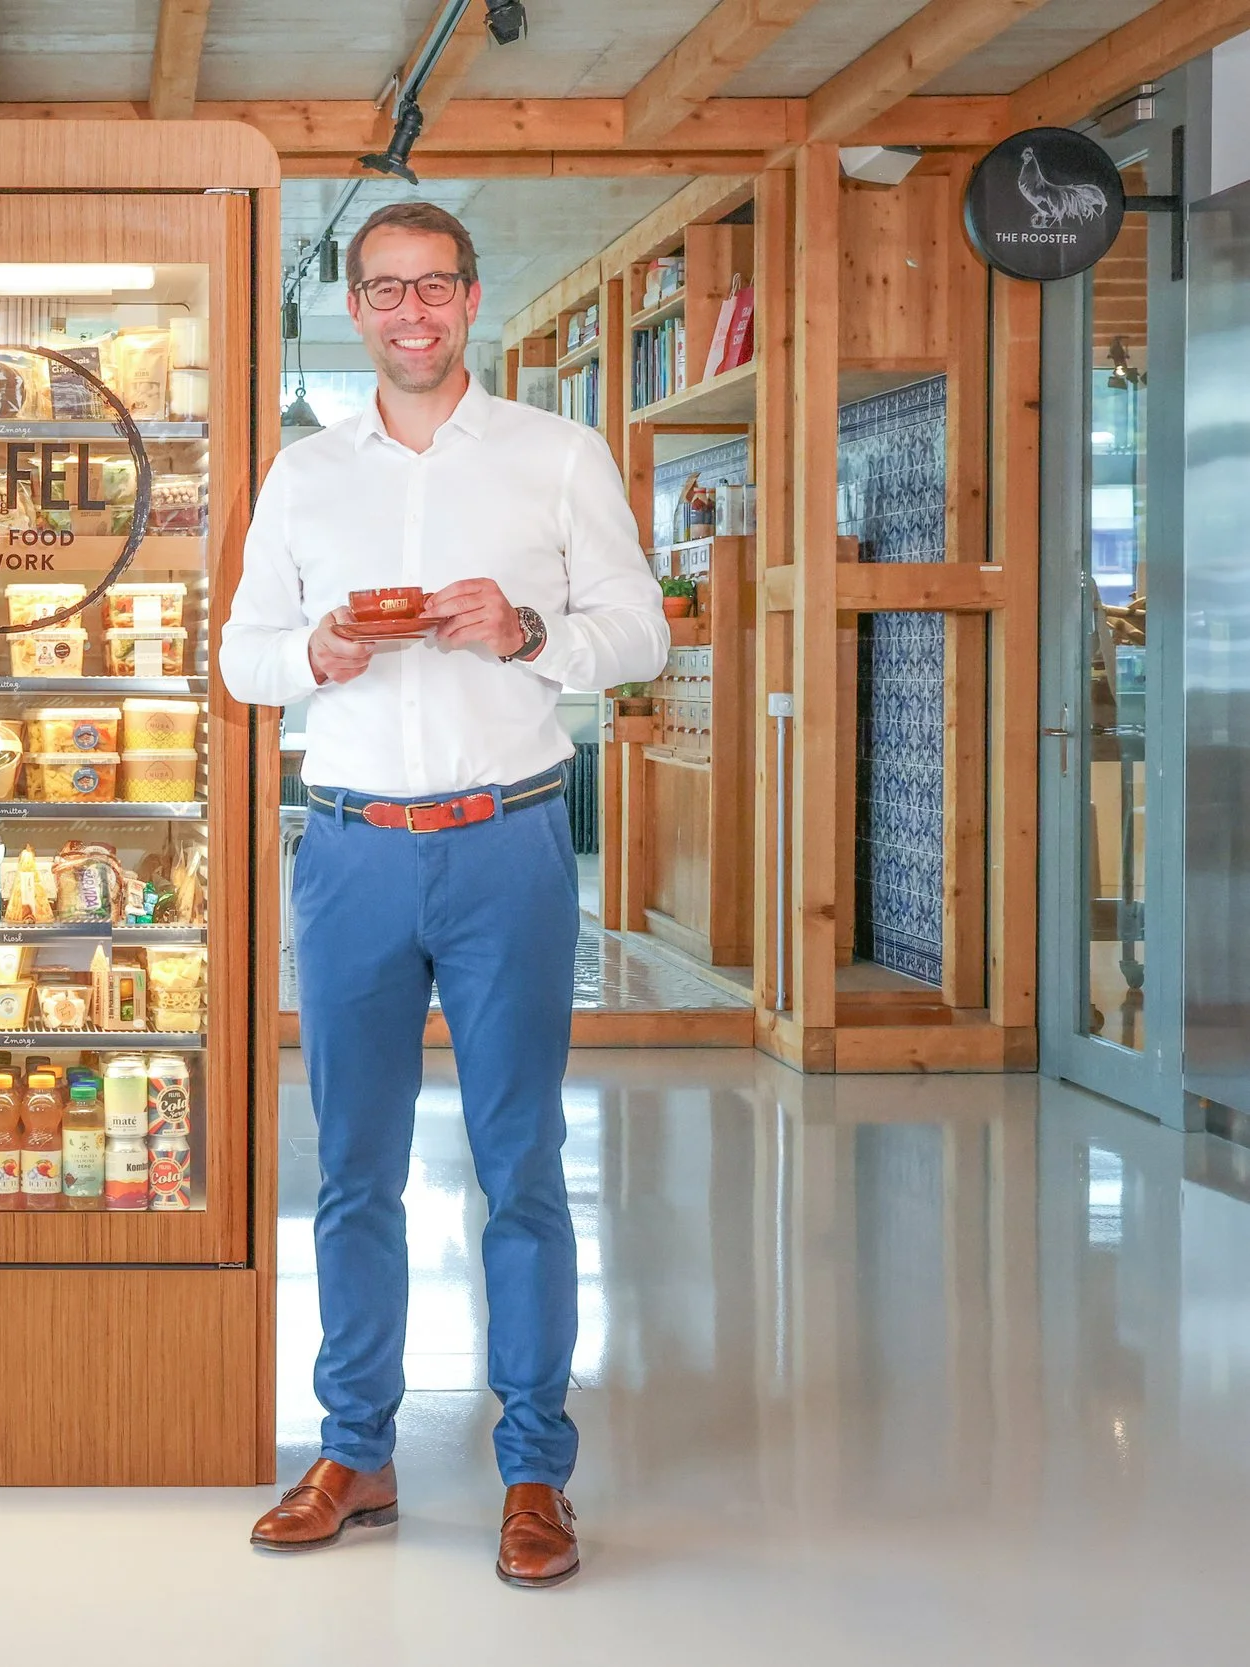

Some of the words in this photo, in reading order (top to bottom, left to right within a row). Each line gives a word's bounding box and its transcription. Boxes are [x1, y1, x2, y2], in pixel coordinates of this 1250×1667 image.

[995, 232, 1018, 243] THE
[1021, 232, 1077, 244] ROOSTER
[0, 425, 31, 438] Zmorge
[9, 529, 75, 547] FOOD
[3, 932, 24, 943] Kiosk
[3, 1035, 36, 1048] Zmorge
[159, 1098, 187, 1112] Cola
[112, 1115, 137, 1126] maté
[151, 1172, 182, 1184] Cola
